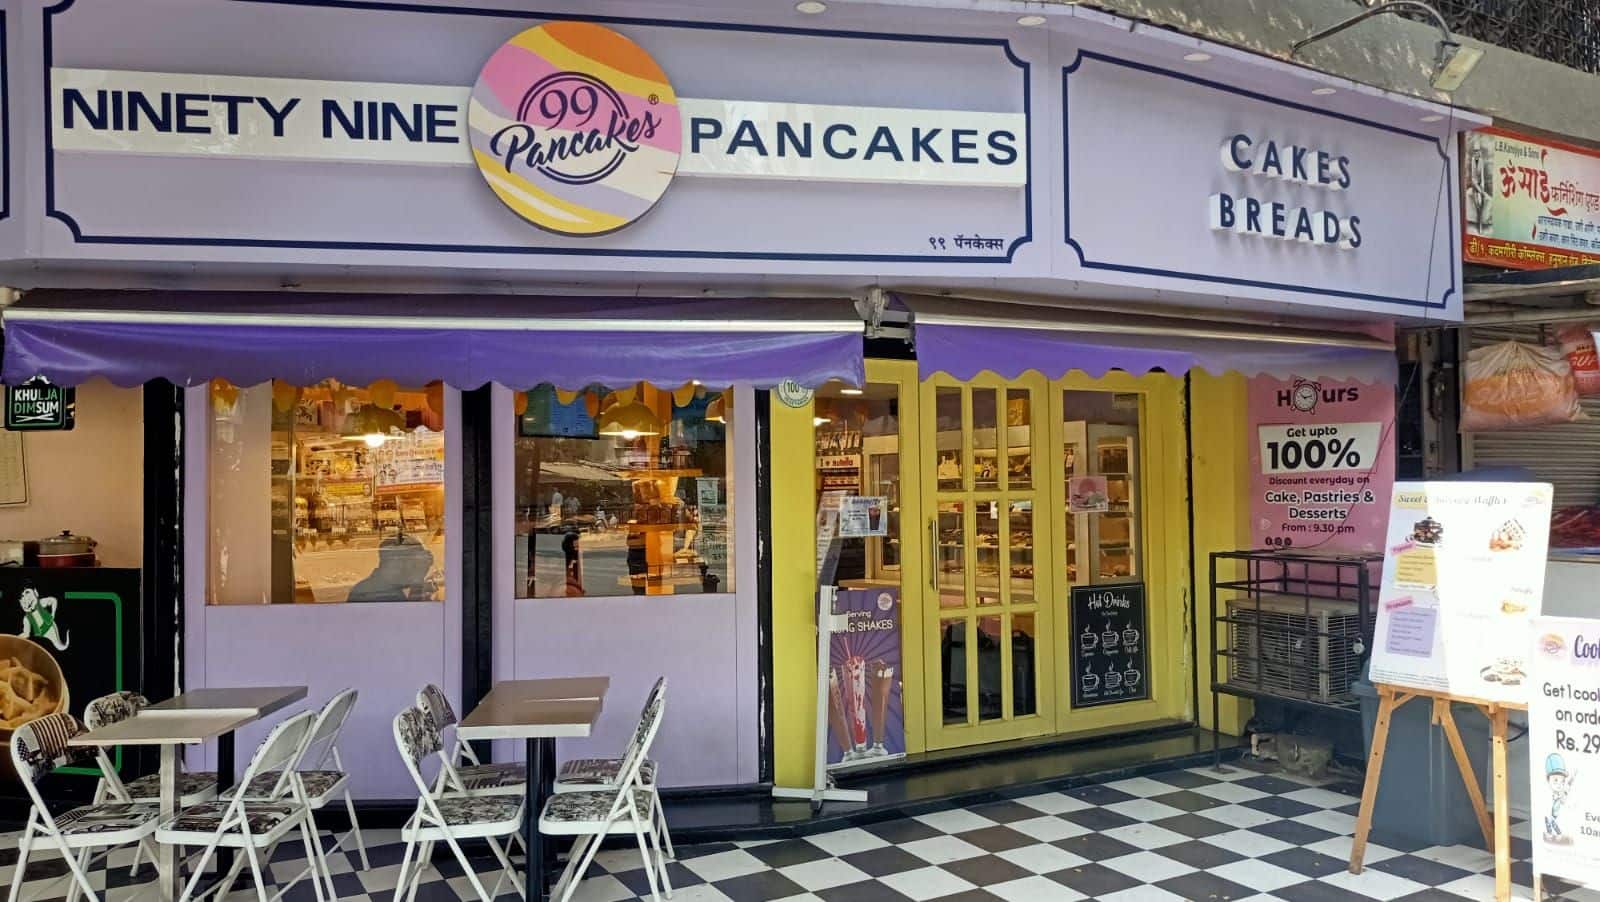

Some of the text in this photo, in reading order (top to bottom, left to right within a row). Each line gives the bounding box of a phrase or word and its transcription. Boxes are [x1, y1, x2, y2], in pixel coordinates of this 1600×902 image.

[63, 88, 459, 144] NINETY NINE
[540, 86, 598, 131] 99
[490, 110, 662, 174] Pancakes
[690, 117, 1018, 166] PANCAKES
[1229, 133, 1351, 189] CAKES
[1220, 193, 1361, 249] BREADS
[14, 389, 58, 401] KHULJA
[14, 401, 59, 414] DIMSUM
[1287, 426, 1338, 438] Get upto
[1267, 438, 1361, 470] 100%
[1269, 476, 1370, 486] Discount everyday on
[1265, 490, 1374, 504] Cake, Pastries &
[1289, 507, 1347, 519] Desserts
[1281, 523, 1306, 532] From
[1337, 524, 1355, 534] pm
[1088, 592, 1131, 610] Hot Drinks
[857, 619, 893, 632] SHAKES
[1574, 634, 1600, 659] Coo
[1543, 682, 1565, 698] Get
[1574, 688, 1600, 702] coo
[1555, 709, 1572, 722] on
[1556, 730, 1579, 752] Rs.
